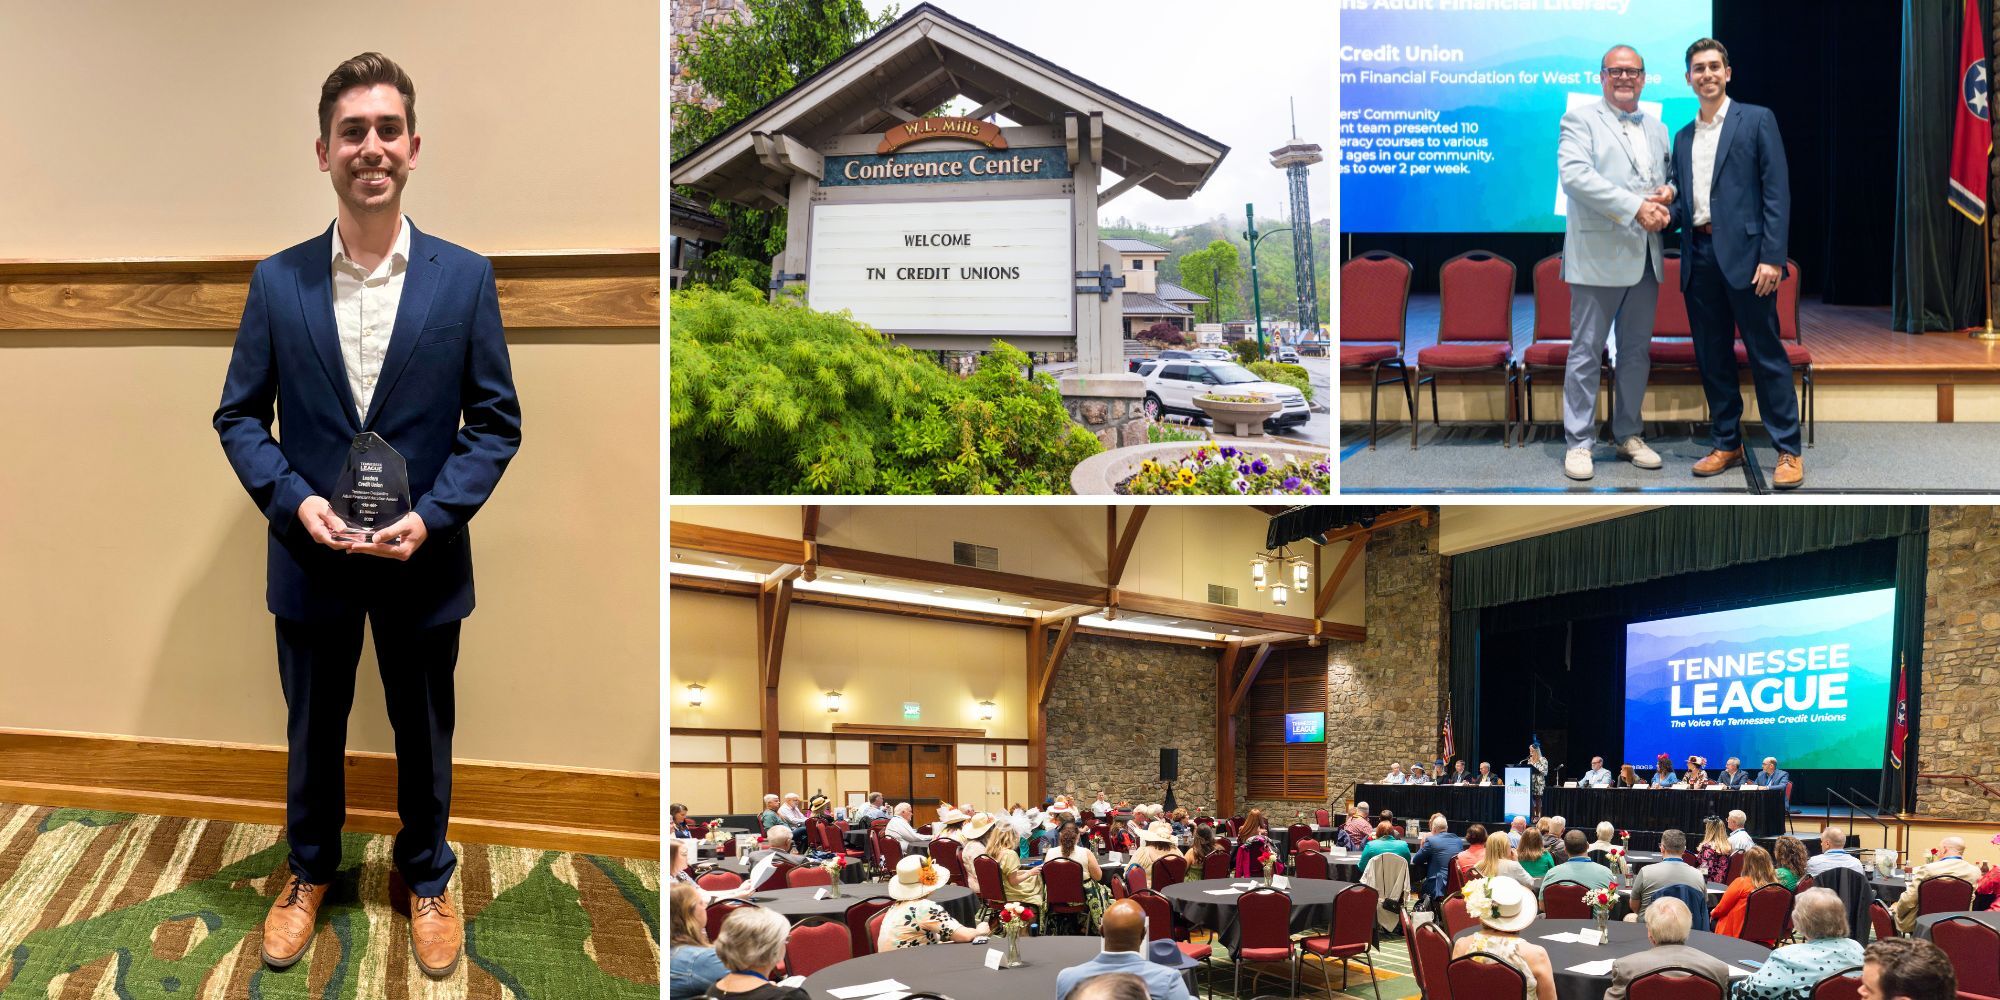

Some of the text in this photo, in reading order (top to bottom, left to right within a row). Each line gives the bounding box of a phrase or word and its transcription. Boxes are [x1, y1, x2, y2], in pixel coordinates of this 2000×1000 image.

[1544, 0, 1630, 15] Literacy
[1340, 44, 1464, 61] Credit Union
[1360, 70, 1426, 84] Financial
[1430, 70, 1514, 84] Foundation
[1519, 70, 1538, 84] for
[1542, 71, 1580, 84] West
[1363, 108, 1440, 122] Community
[904, 119, 980, 136] W.L. Mills
[1357, 123, 1390, 133] team
[1393, 122, 1458, 135] presented
[1461, 122, 1479, 133] 110
[1375, 138, 1424, 147] courses
[1427, 136, 1440, 147] to
[1443, 137, 1488, 147] various
[1346, 151, 1376, 163] ages
[1379, 150, 1391, 160] in
[1393, 151, 1415, 161] our
[1418, 150, 1495, 163] community.
[843, 155, 1043, 181] Conference Center
[1353, 164, 1366, 174] to
[1368, 165, 1396, 174] over
[1399, 163, 1407, 174] 2
[1410, 165, 1431, 176] per
[1433, 163, 1471, 174] week.
[904, 234, 971, 247] WELCOME
[866, 266, 1020, 280] TN CREDIT UNIONS
[1668, 643, 1850, 682] TENNESSEE
[1670, 672, 1849, 717] LEAGUE
[1670, 712, 1847, 728] The Voice for Tennessee Credit Unions
